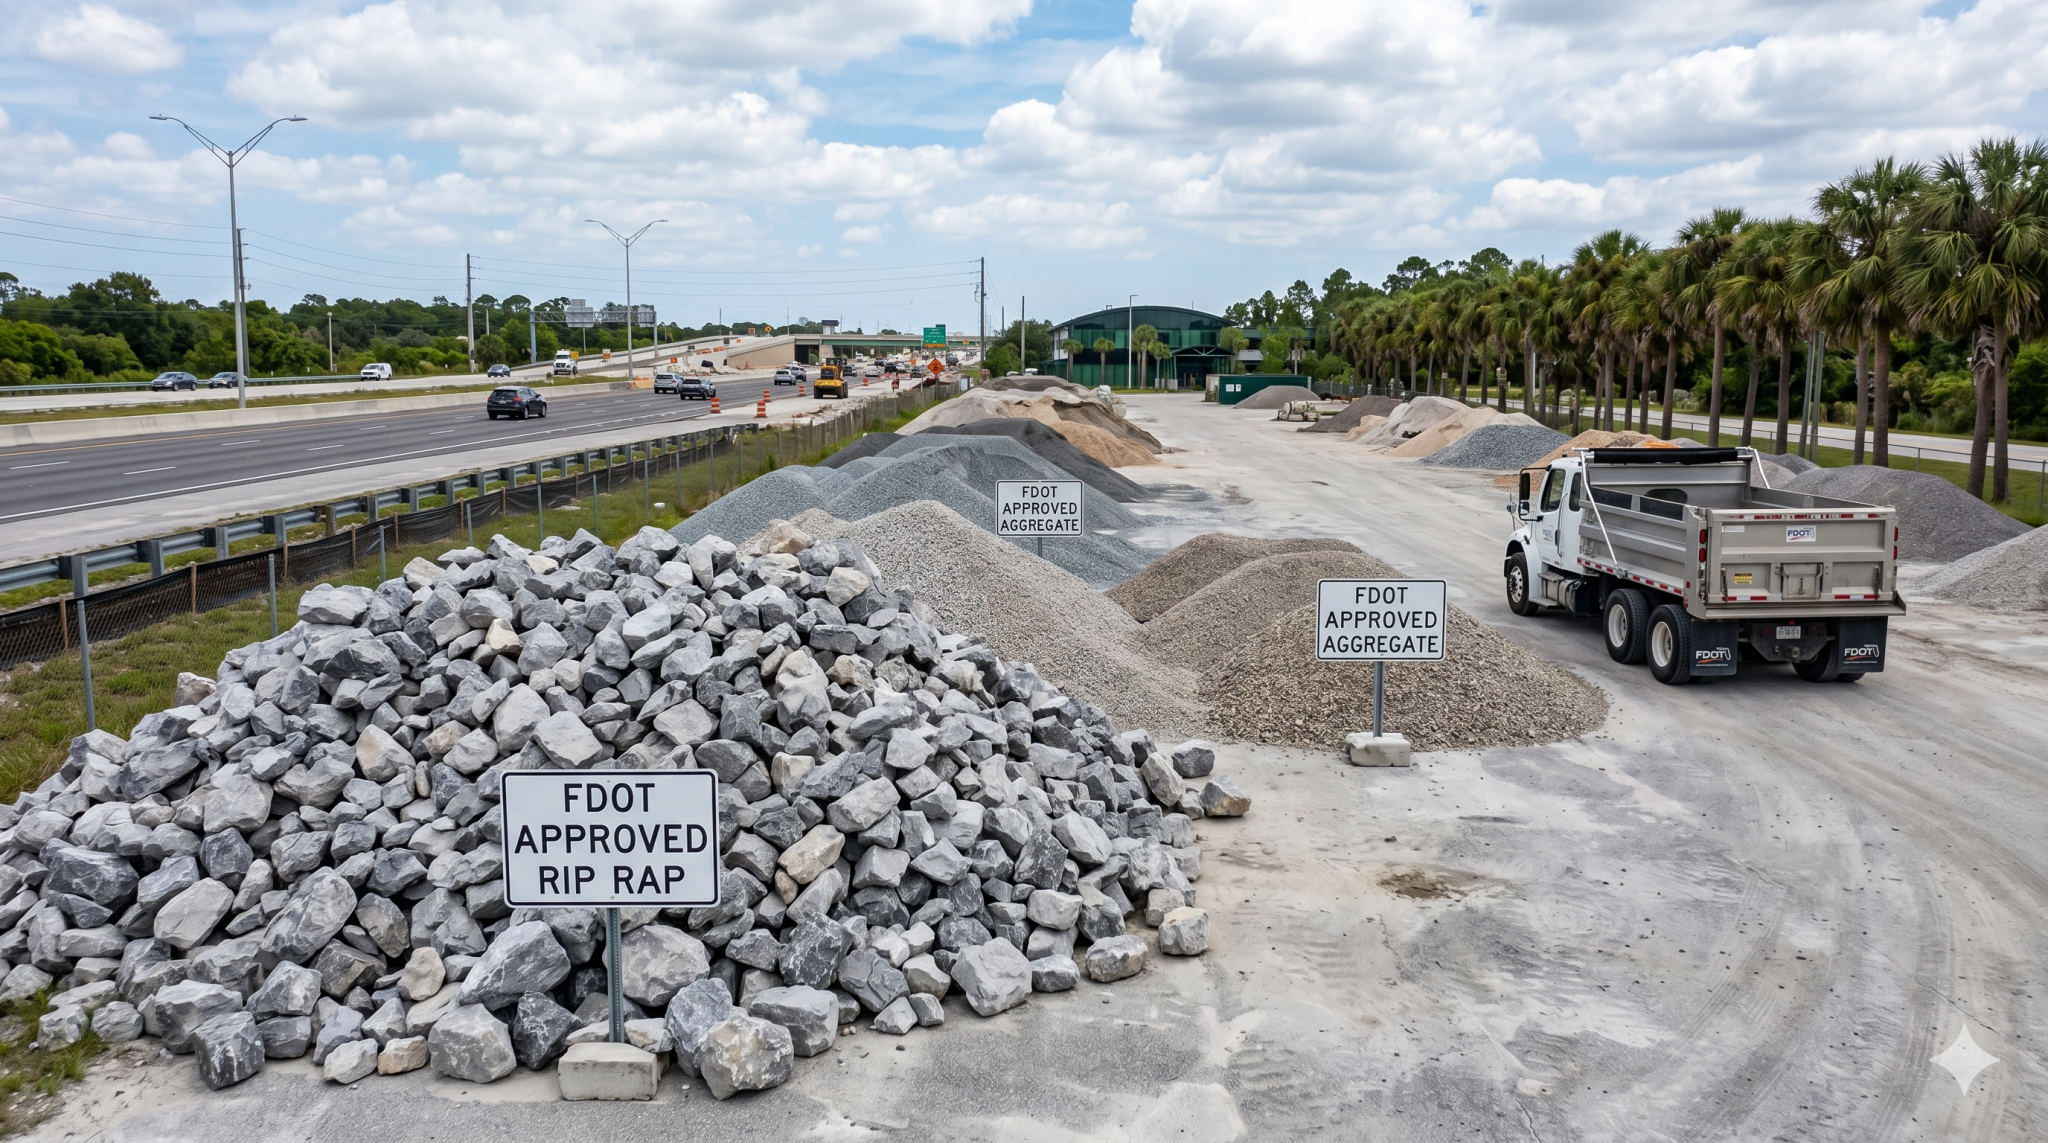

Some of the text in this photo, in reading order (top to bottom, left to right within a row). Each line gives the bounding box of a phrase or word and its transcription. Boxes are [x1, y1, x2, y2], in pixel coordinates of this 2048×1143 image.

[1022, 485, 1058, 498] FDOT
[1002, 502, 1078, 515] APPROVED
[1000, 519, 1079, 532] AGGREGATE
[1355, 586, 1409, 604] FDOT
[1324, 611, 1438, 629] APPROVED
[1322, 635, 1439, 653] AGGREGATE
[1844, 647, 1873, 656] FDOT
[1695, 650, 1727, 659] FDOT
[564, 783, 656, 813] FDOT
[514, 824, 708, 854] APPROVED
[539, 865, 685, 895] RIP RAP
